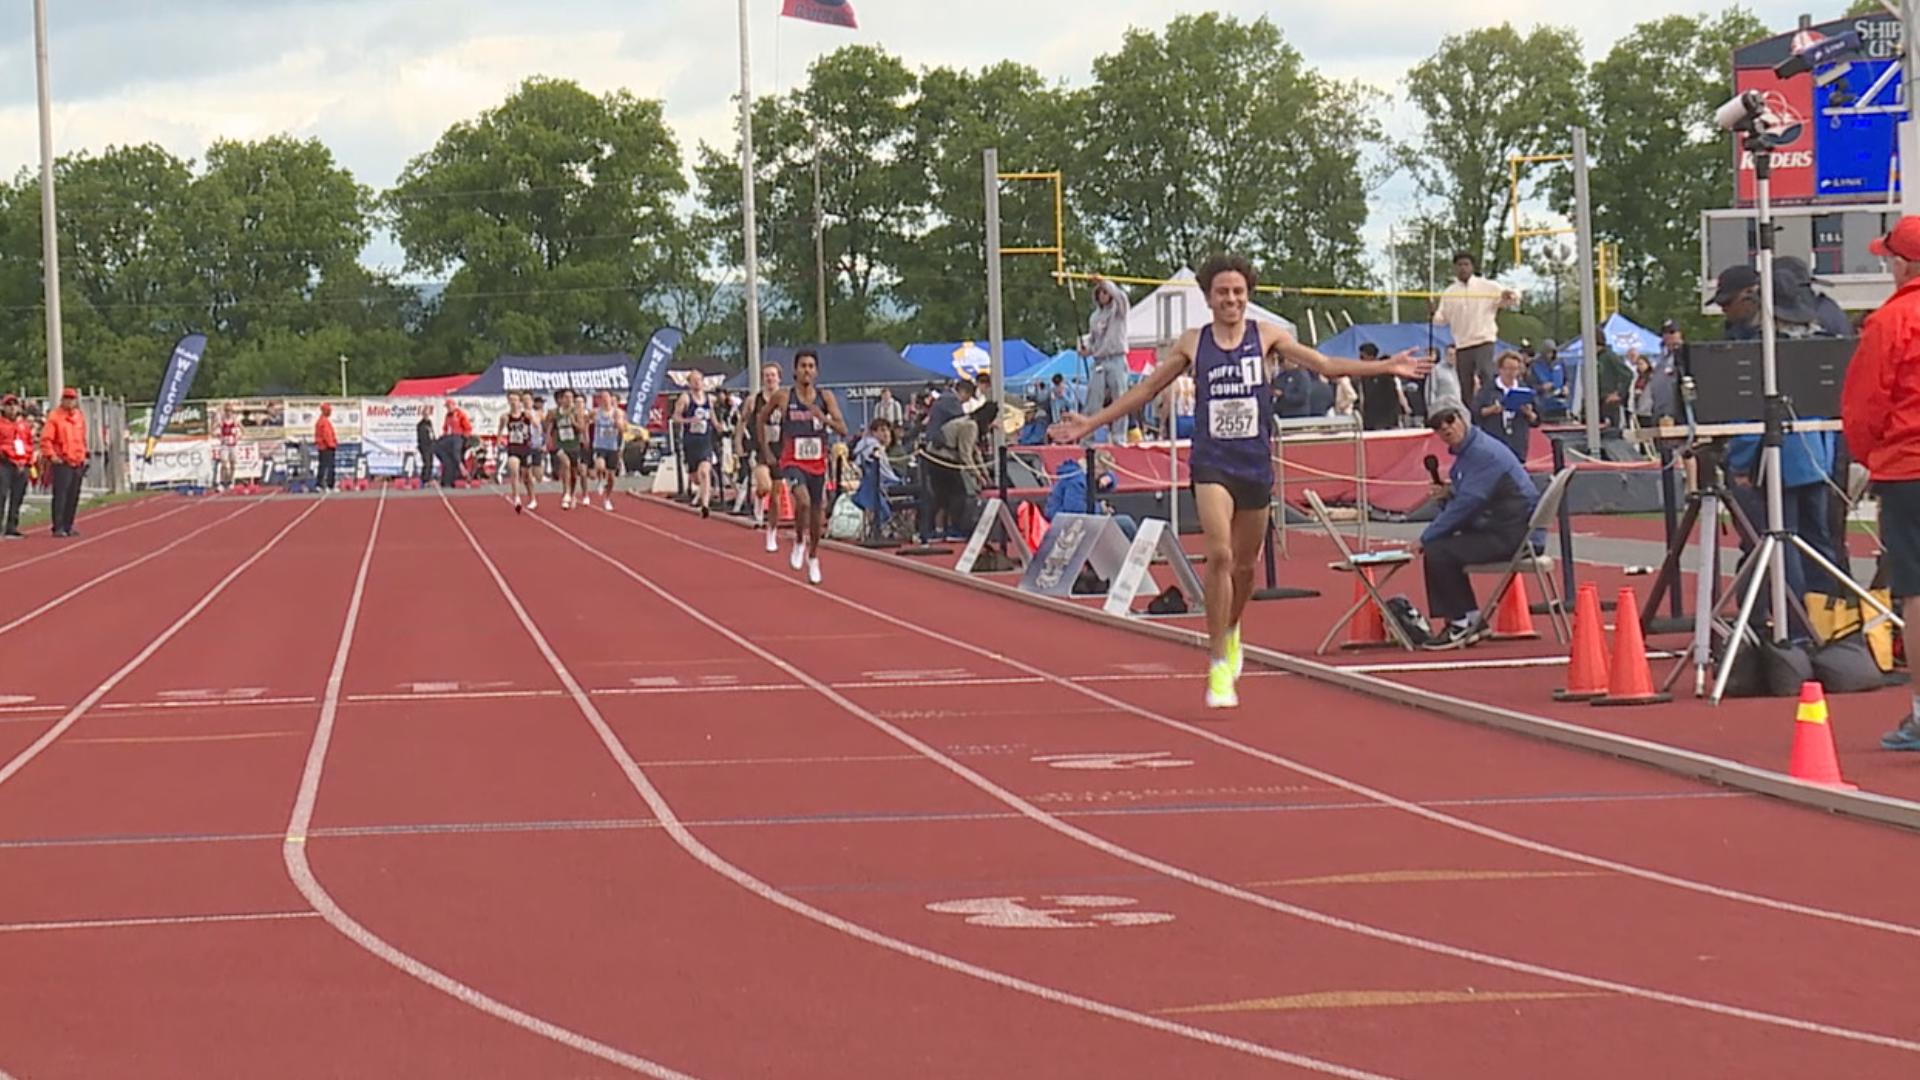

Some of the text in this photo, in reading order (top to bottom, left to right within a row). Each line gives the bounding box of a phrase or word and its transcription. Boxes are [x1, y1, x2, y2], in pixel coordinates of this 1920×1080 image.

[1740, 150, 1813, 169] RDERS
[502, 365, 629, 390] ABINGTON HEIGHTS
[1208, 365, 1242, 382] MIFFL
[1246, 360, 1256, 382] 1
[155, 357, 192, 436] WELCOME
[632, 347, 665, 425] WELCOME
[1215, 415, 1253, 432] 2557
